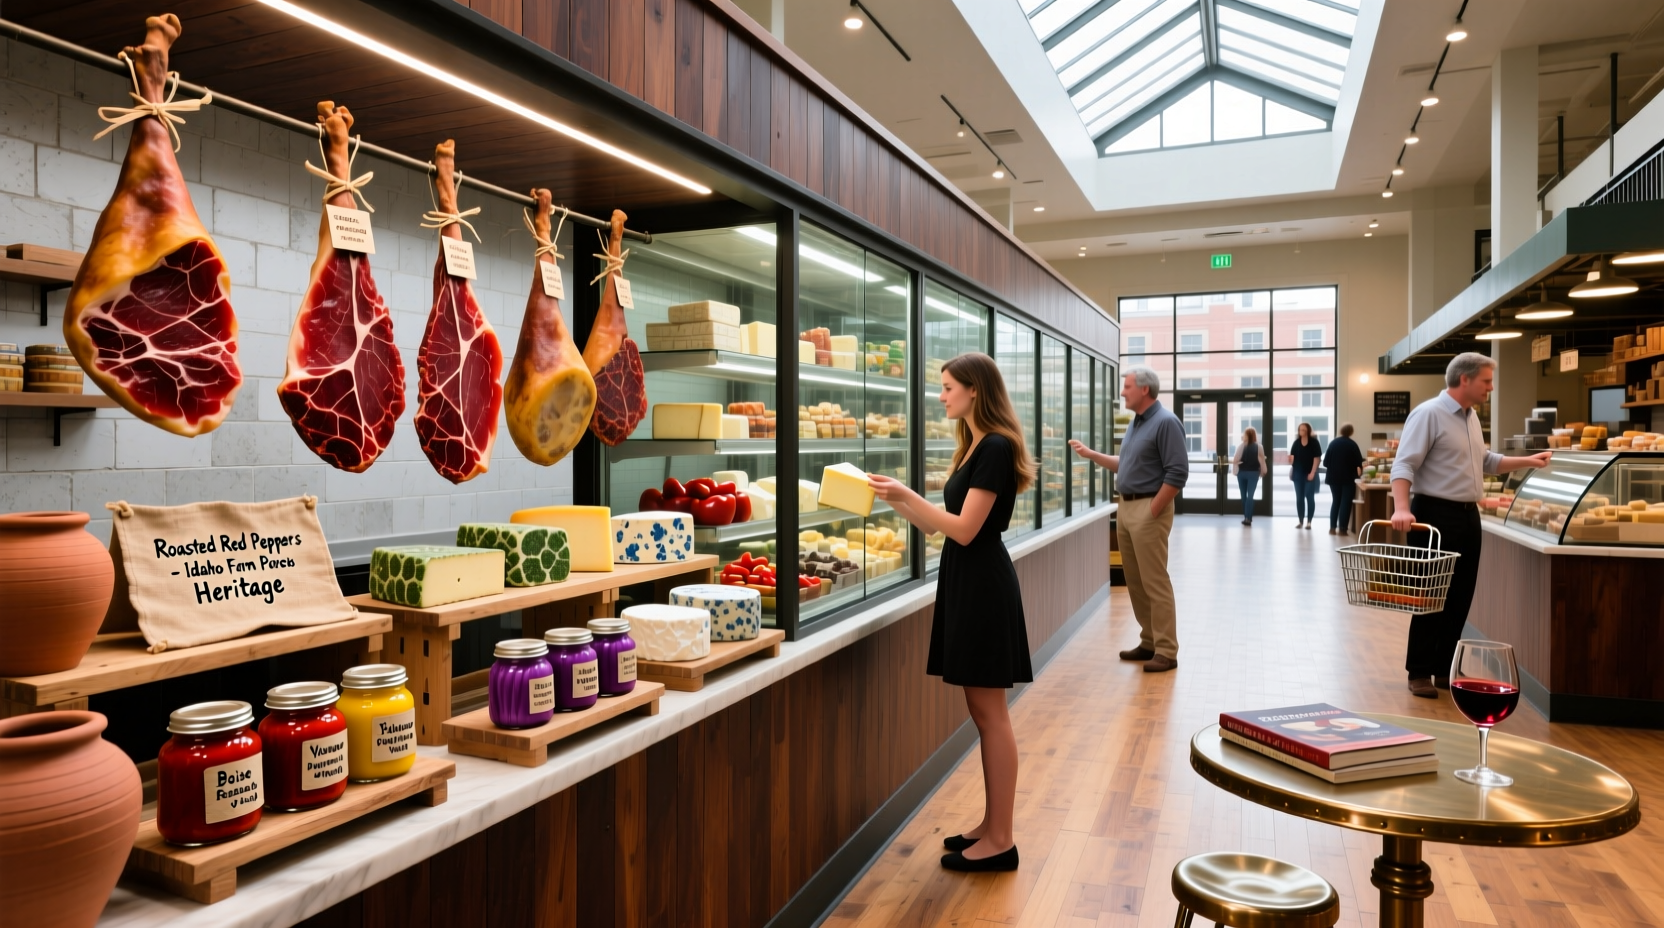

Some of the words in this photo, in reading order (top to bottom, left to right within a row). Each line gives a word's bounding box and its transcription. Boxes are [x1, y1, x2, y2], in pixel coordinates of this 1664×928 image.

[153, 534, 217, 558] Roasted
[219, 531, 247, 552] Red
[250, 532, 302, 554] Peppers
[184, 559, 224, 577] Idaho
[193, 577, 285, 604] Heritage
